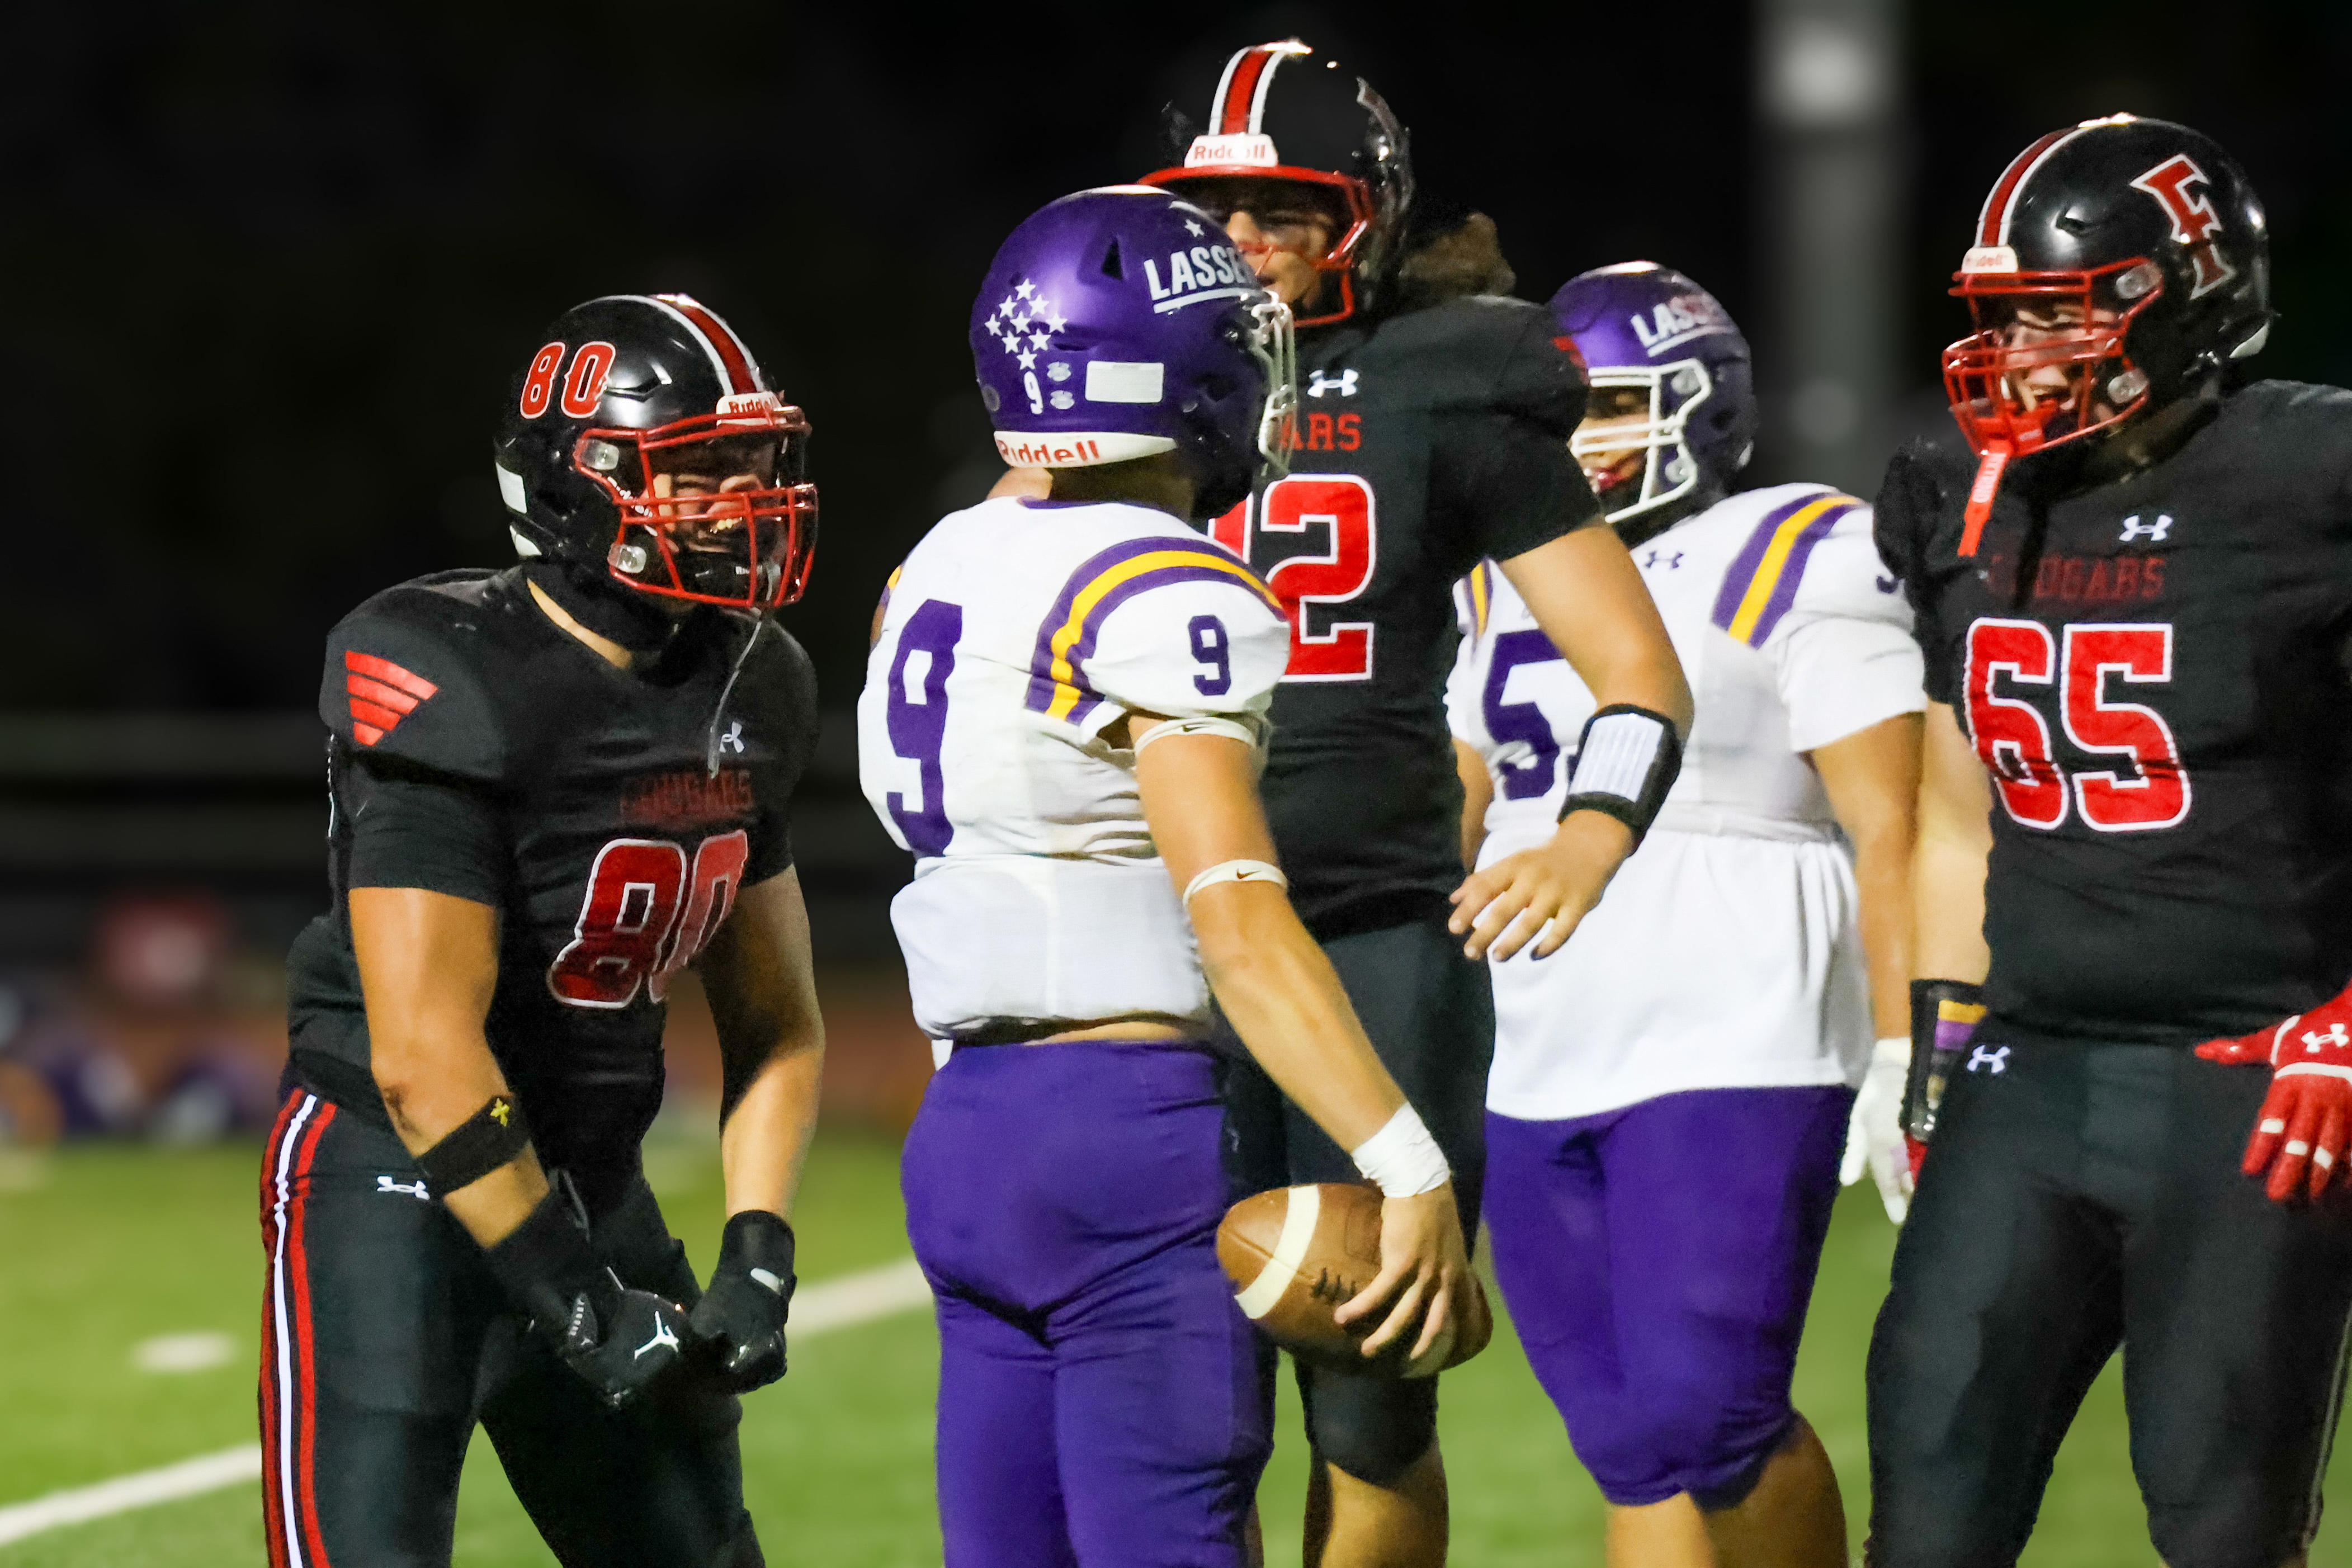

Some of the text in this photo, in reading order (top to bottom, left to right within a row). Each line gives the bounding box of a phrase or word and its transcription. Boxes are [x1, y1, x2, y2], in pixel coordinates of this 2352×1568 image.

[520, 341, 616, 419] 80
[1024, 371, 1043, 414] 9
[1187, 614, 1231, 696] 9
[1208, 474, 1376, 682] 2
[887, 598, 963, 857] 9
[1482, 629, 1580, 801] 5
[1963, 617, 2192, 832] 65
[546, 830, 749, 1008] 80
